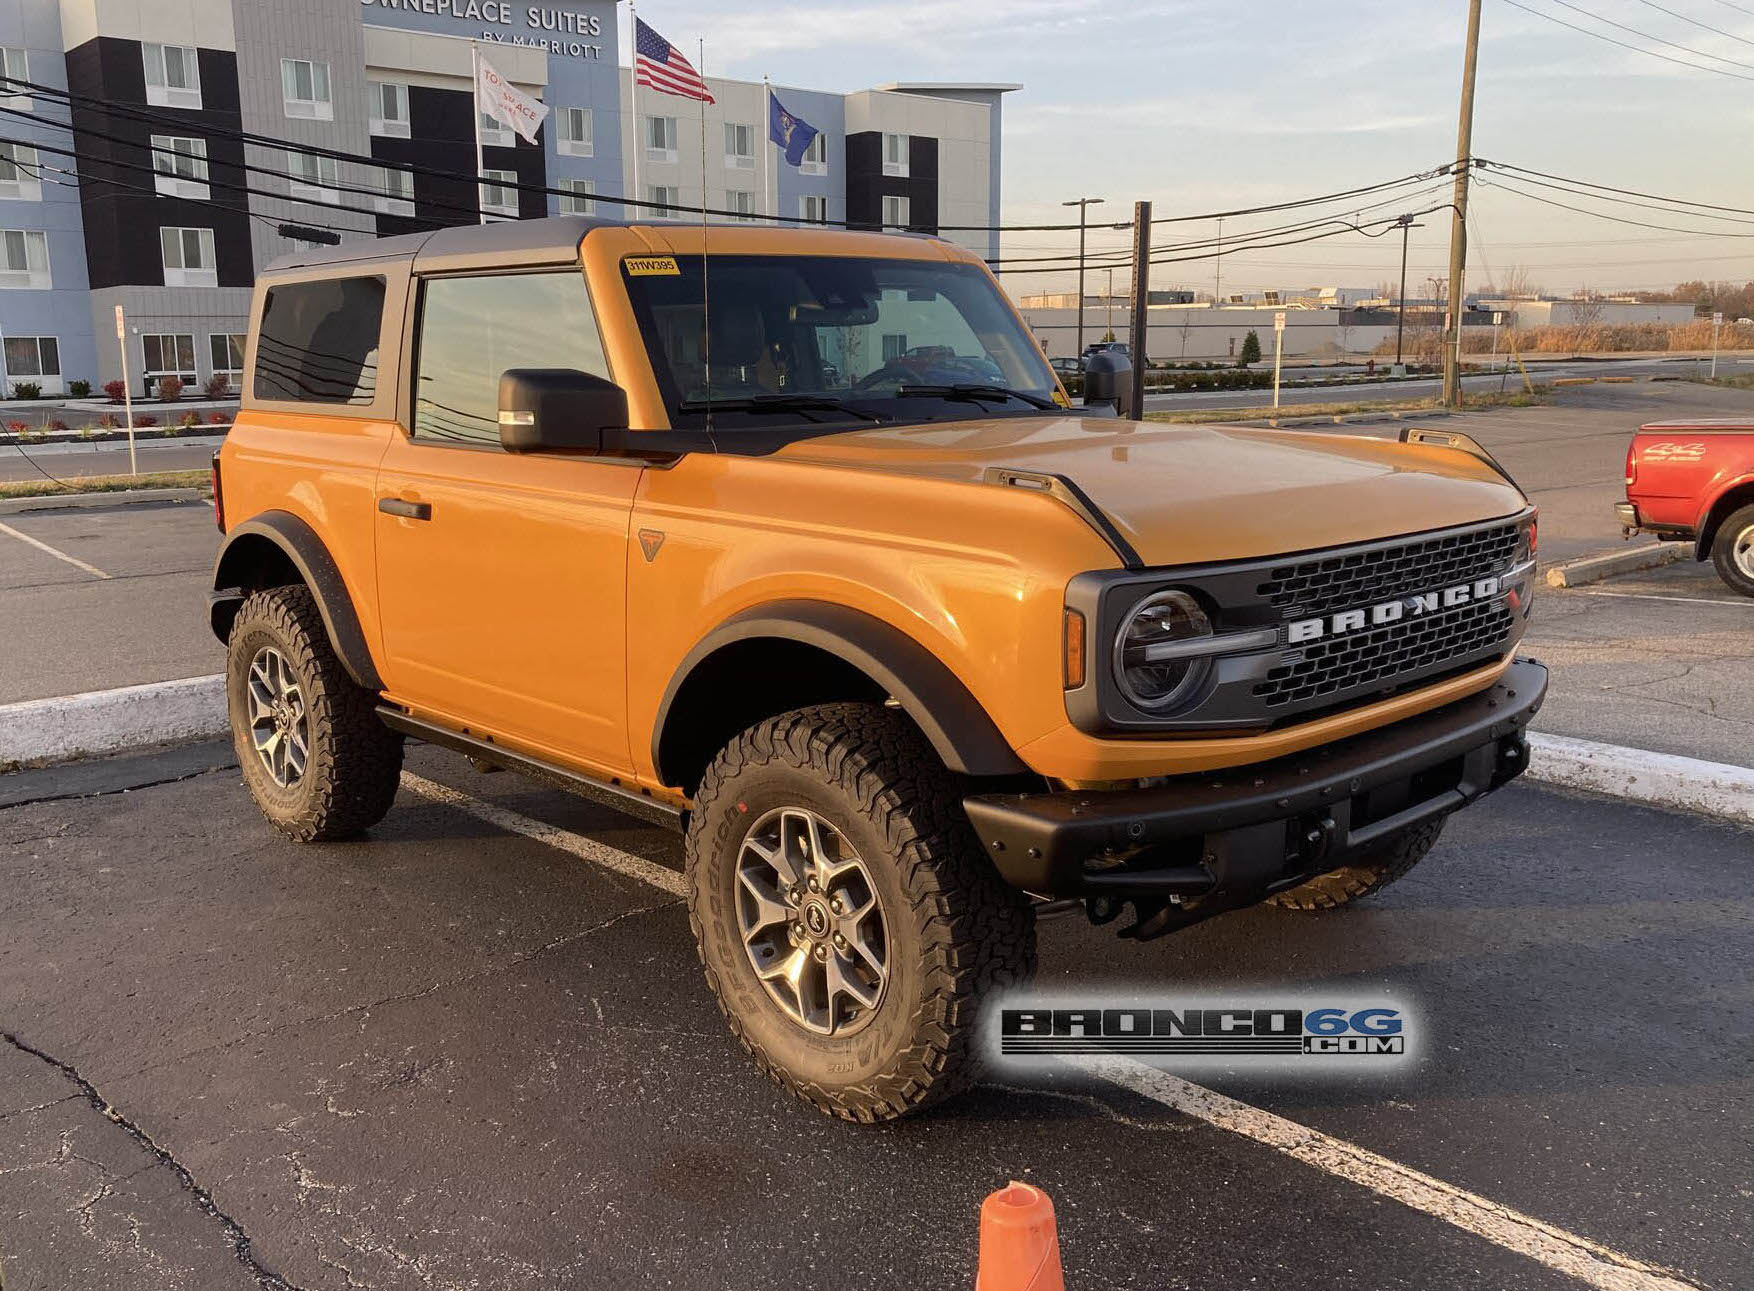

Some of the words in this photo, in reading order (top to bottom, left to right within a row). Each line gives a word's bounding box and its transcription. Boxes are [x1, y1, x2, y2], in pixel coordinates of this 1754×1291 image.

[361, 0, 511, 24] NEPLACE
[527, 7, 601, 36] SUITES
[482, 31, 505, 42] BY
[511, 36, 602, 59] MARRIOTT
[627, 261, 675, 271] 311W395
[1288, 577, 1498, 643] BRONCO
